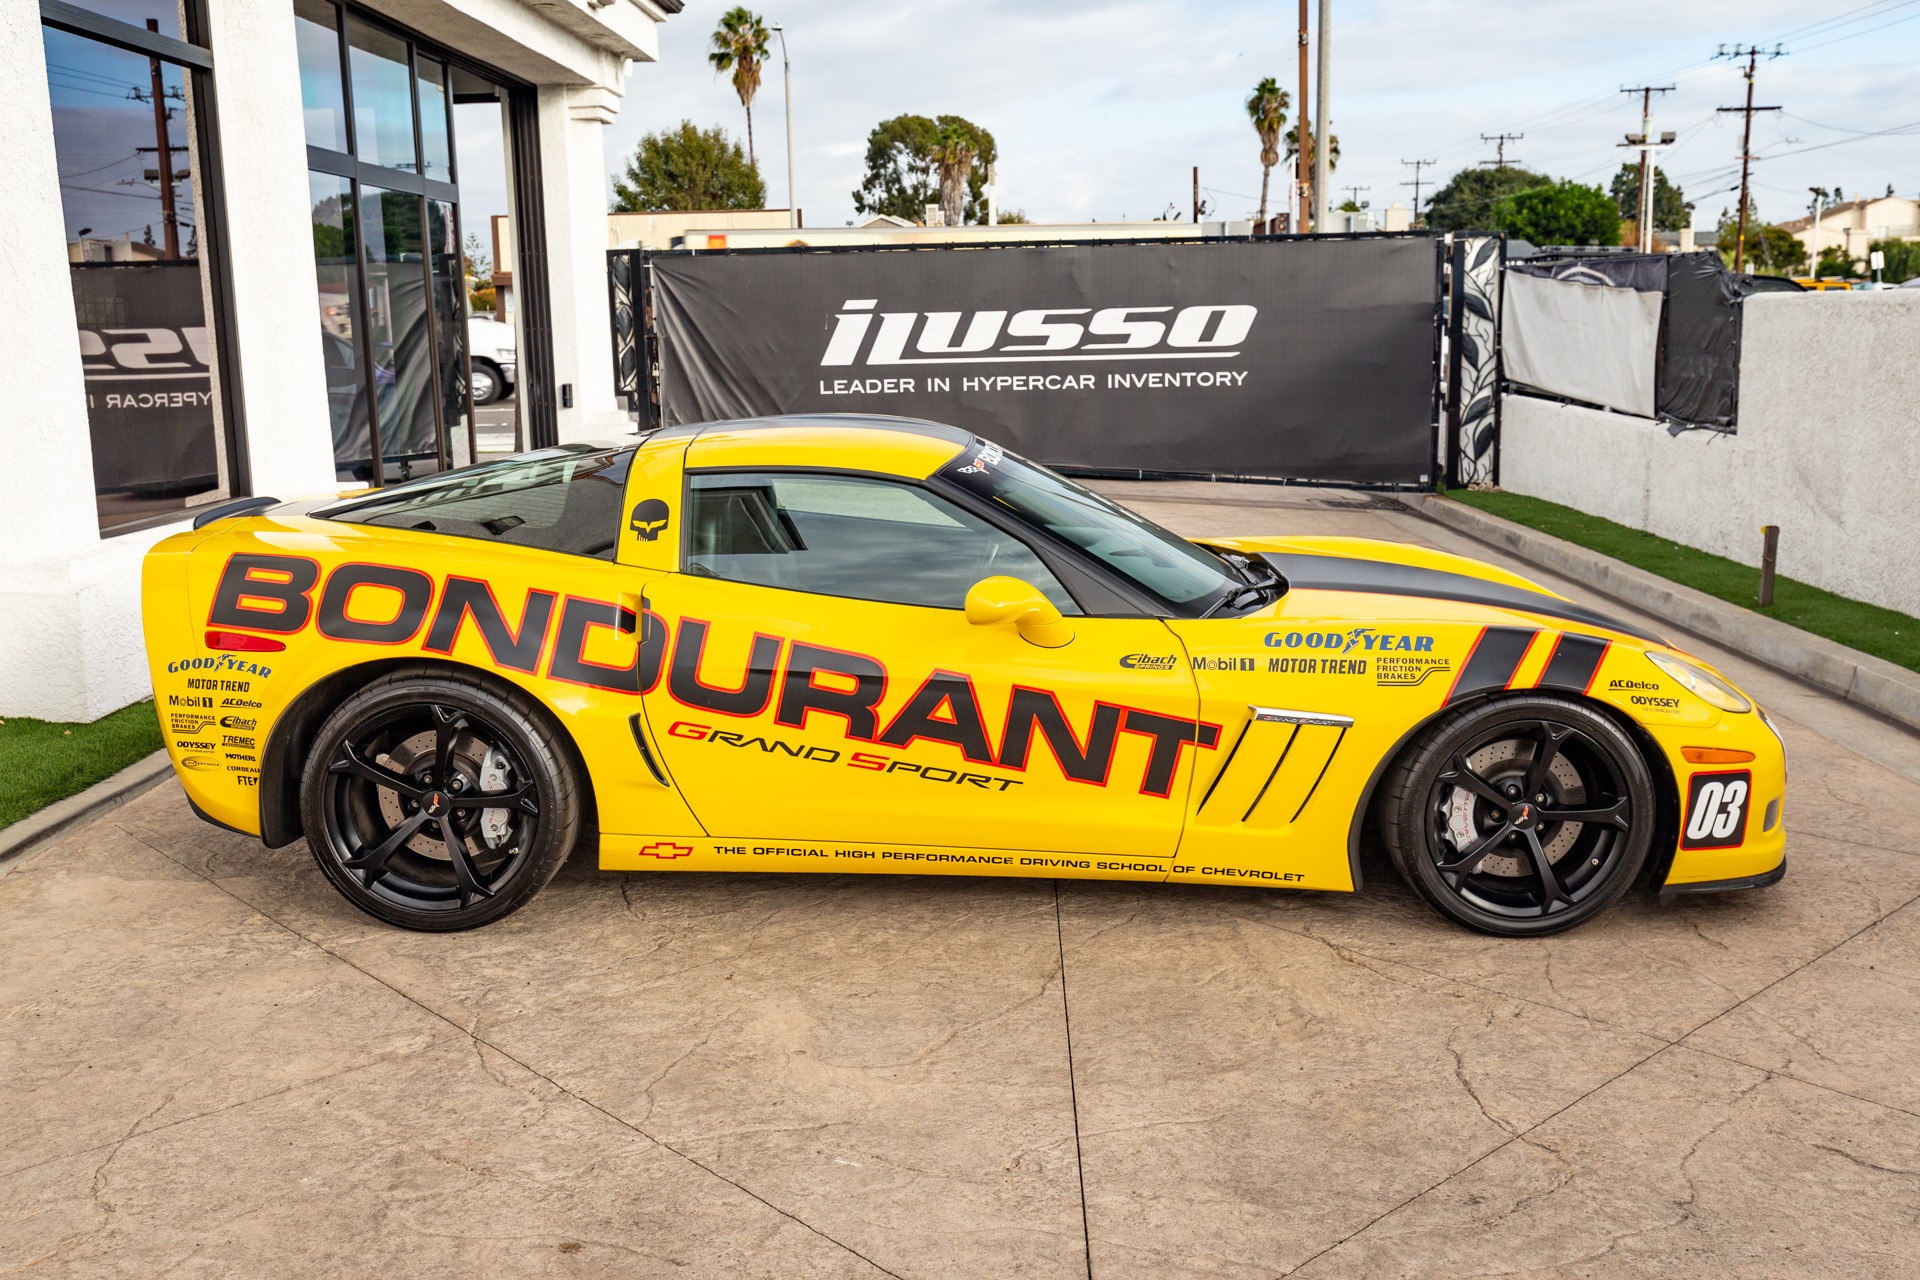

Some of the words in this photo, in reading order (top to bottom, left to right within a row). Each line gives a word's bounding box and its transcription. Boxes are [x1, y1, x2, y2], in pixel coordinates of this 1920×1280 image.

[819, 378, 915, 395] LEADER
[927, 377, 950, 392] IN
[962, 374, 1096, 392] HYPERCAR
[1107, 370, 1249, 390] INVENTORY
[1119, 653, 1177, 669] Eibach
[1192, 656, 1237, 671] Mobil
[1268, 658, 1317, 674] MOTOR
[1320, 659, 1367, 675] TREND
[1376, 657, 1450, 665] PERFORMANCE
[1376, 664, 1422, 672] FRICTION
[205, 552, 1221, 799] BONDURANT
[1376, 672, 1416, 680] BRAKES
[187, 678, 218, 691] MOTOR
[220, 680, 250, 693] TREND
[1609, 679, 1660, 691] ACDelco
[169, 694, 201, 707] Mobil
[221, 697, 262, 709] ACDelco
[1630, 695, 1680, 708] ODYSSEY
[220, 716, 257, 728] Eibach
[176, 740, 216, 750] ODYSSEY
[222, 735, 255, 746] TREMEC
[225, 753, 256, 762] MOTHERS
[667, 720, 841, 763] GRAND
[847, 751, 1024, 791] SPORT
[1686, 780, 1748, 840] 03
[714, 846, 746, 855] THE
[753, 846, 829, 857] OFFICIAL
[835, 850, 876, 859] HIGH
[882, 851, 1013, 865] PERFORMANCE
[1020, 857, 1090, 869] DRIVING
[1097, 861, 1167, 873] SCHOOL
[1173, 865, 1195, 874] OF
[1201, 866, 1305, 882] CHEVROLET
